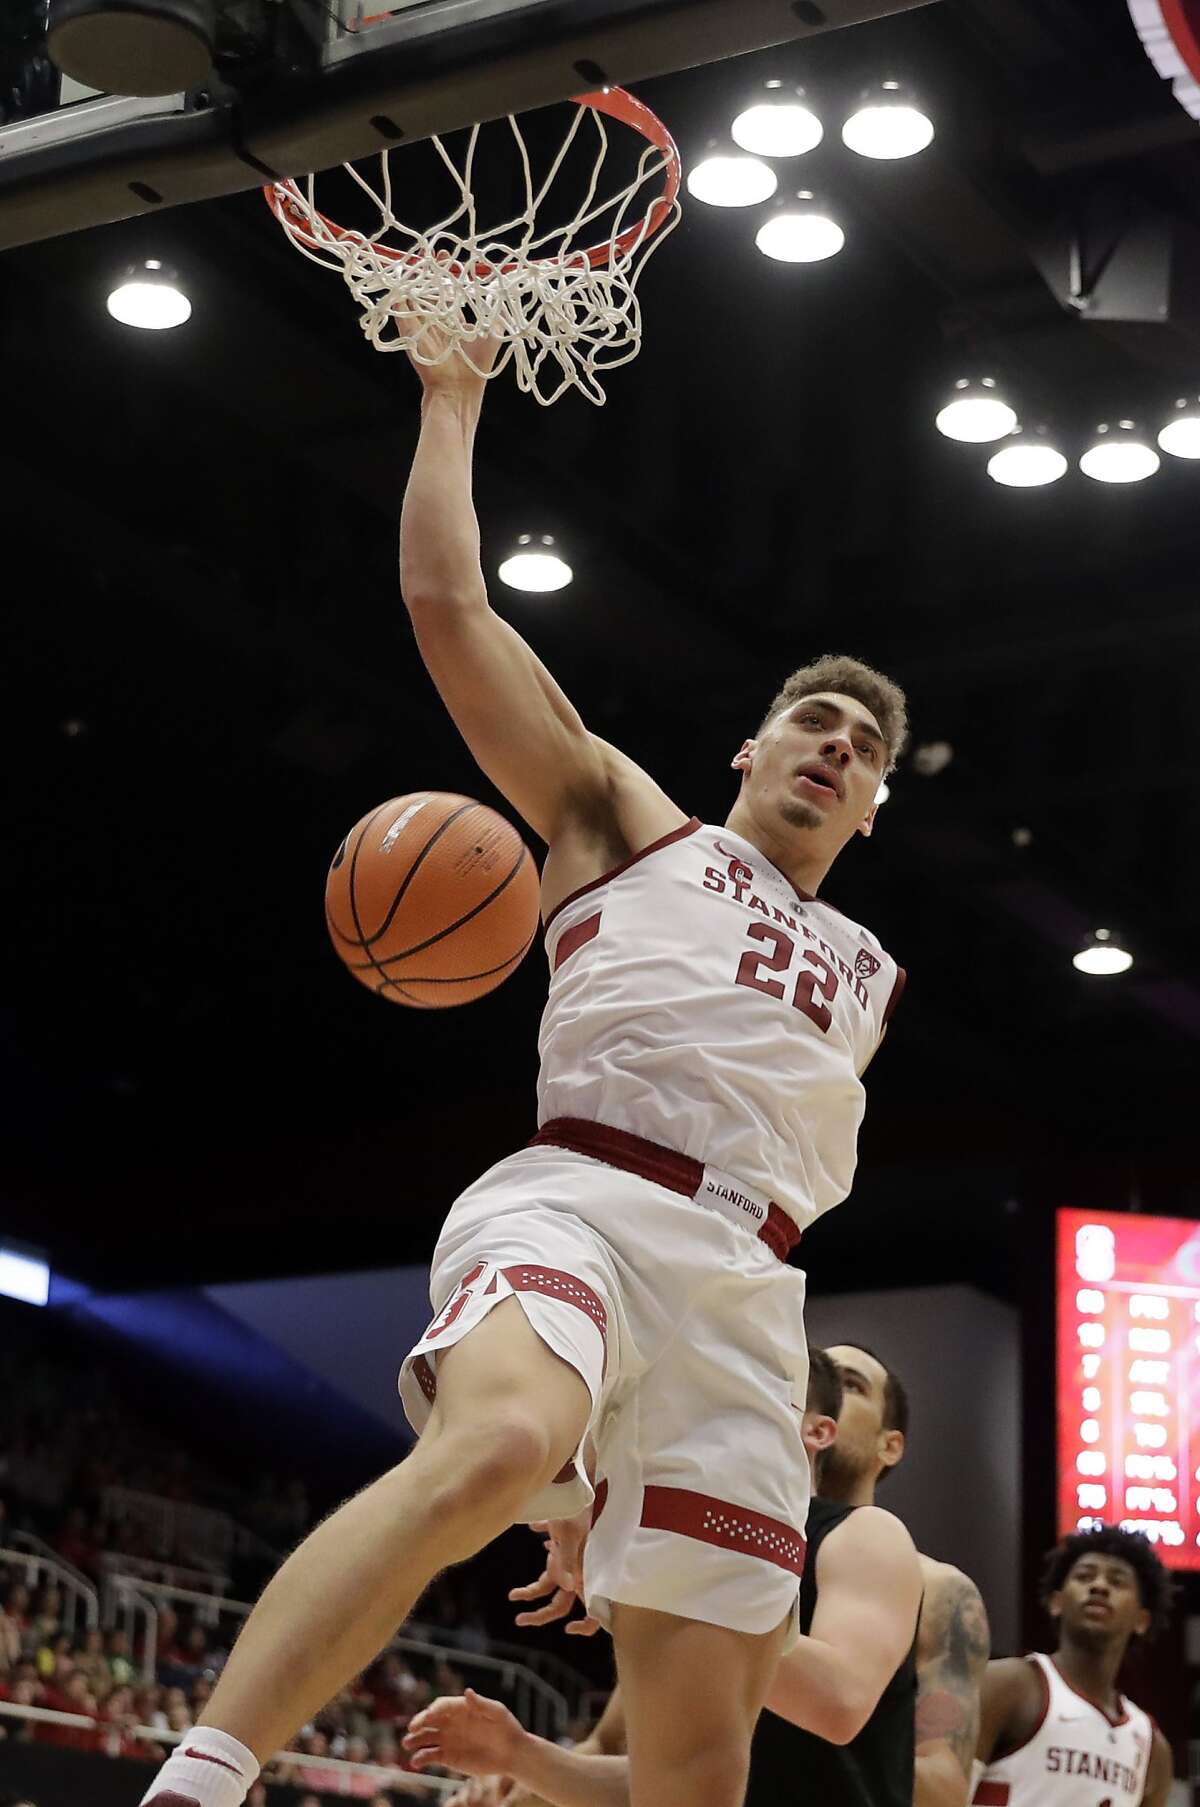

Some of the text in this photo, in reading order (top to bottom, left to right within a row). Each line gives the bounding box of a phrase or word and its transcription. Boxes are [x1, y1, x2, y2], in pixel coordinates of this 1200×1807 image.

[735, 922, 839, 1034] 22
[706, 1181, 764, 1220] STANFORD
[1046, 1747, 1137, 1793] STANF
